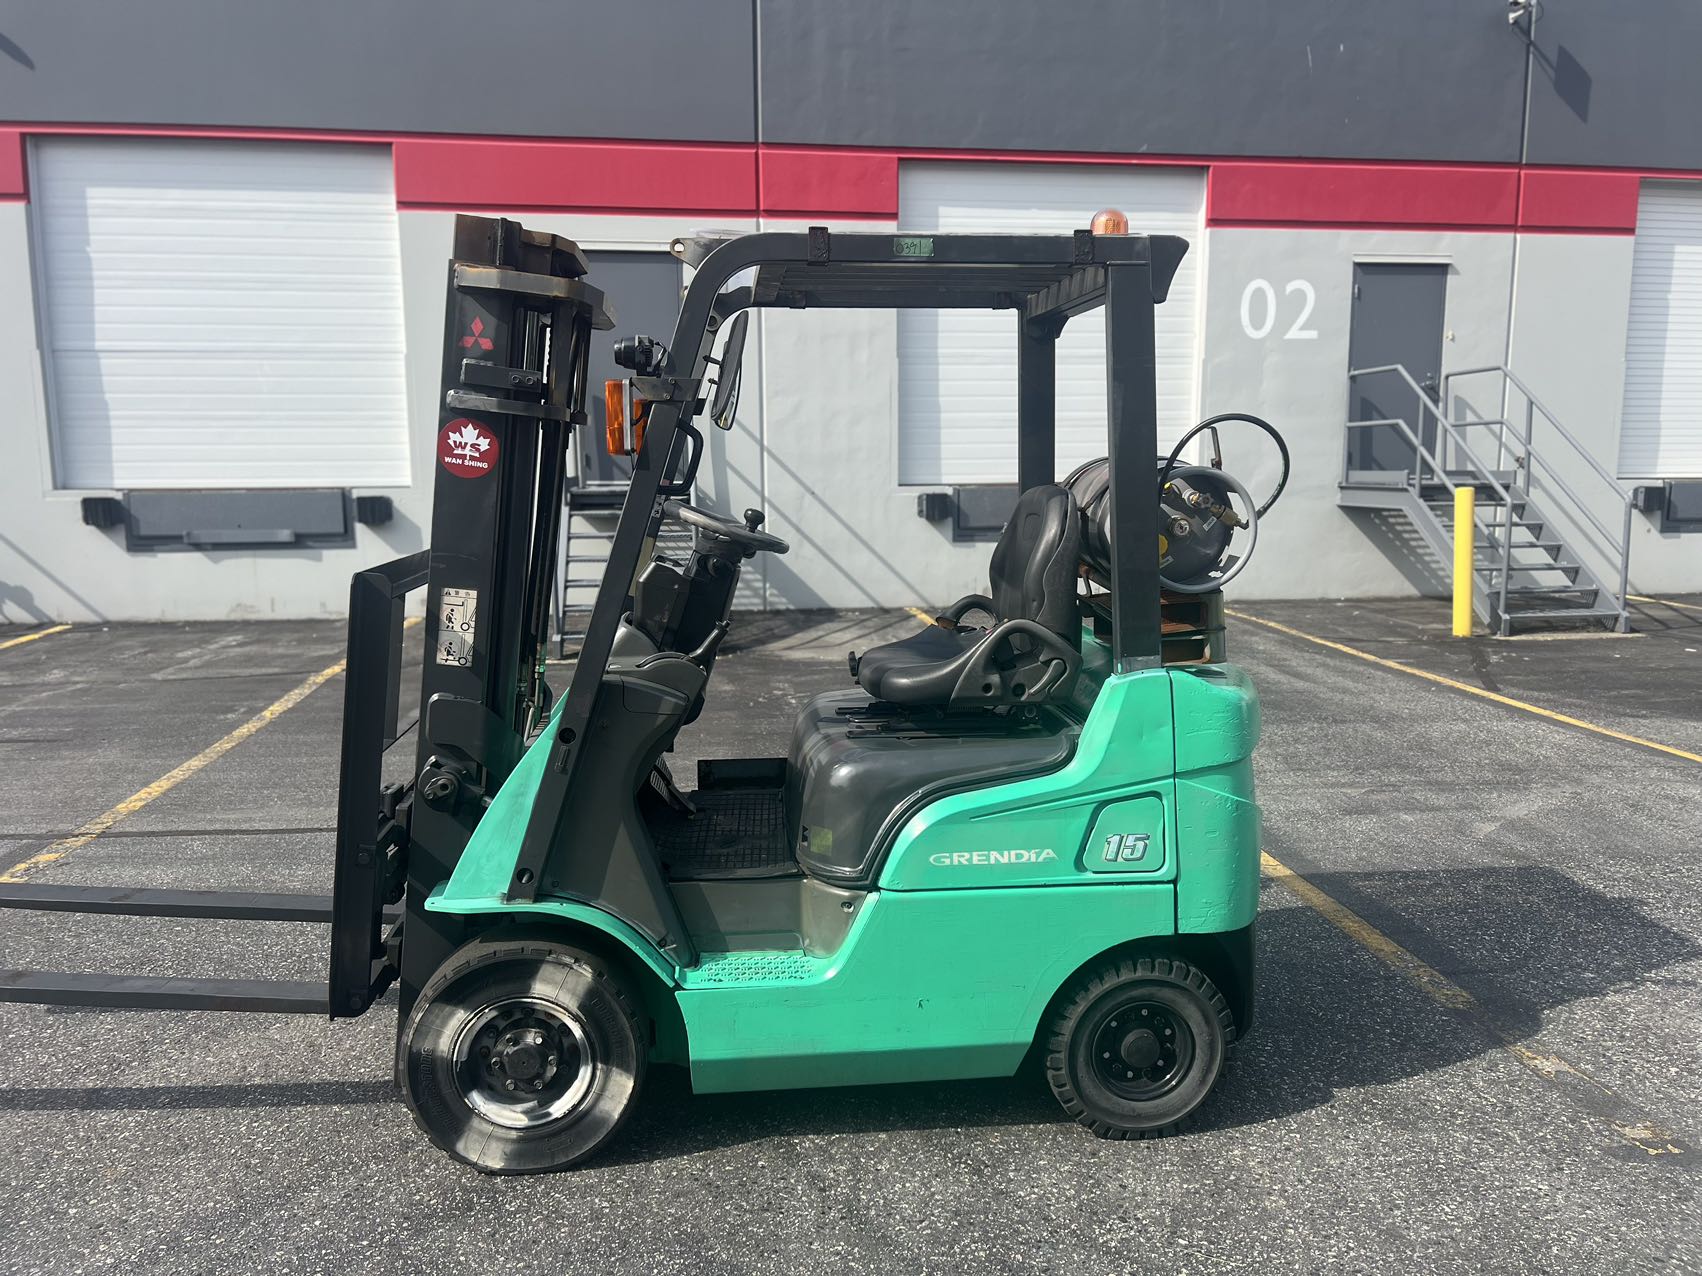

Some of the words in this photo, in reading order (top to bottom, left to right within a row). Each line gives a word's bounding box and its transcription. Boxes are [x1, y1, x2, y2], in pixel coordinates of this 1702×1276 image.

[1240, 278, 1319, 340] 02
[452, 440, 482, 453] WS
[444, 456, 462, 464] WAN
[463, 459, 488, 468] SHING
[1104, 833, 1150, 862] 15
